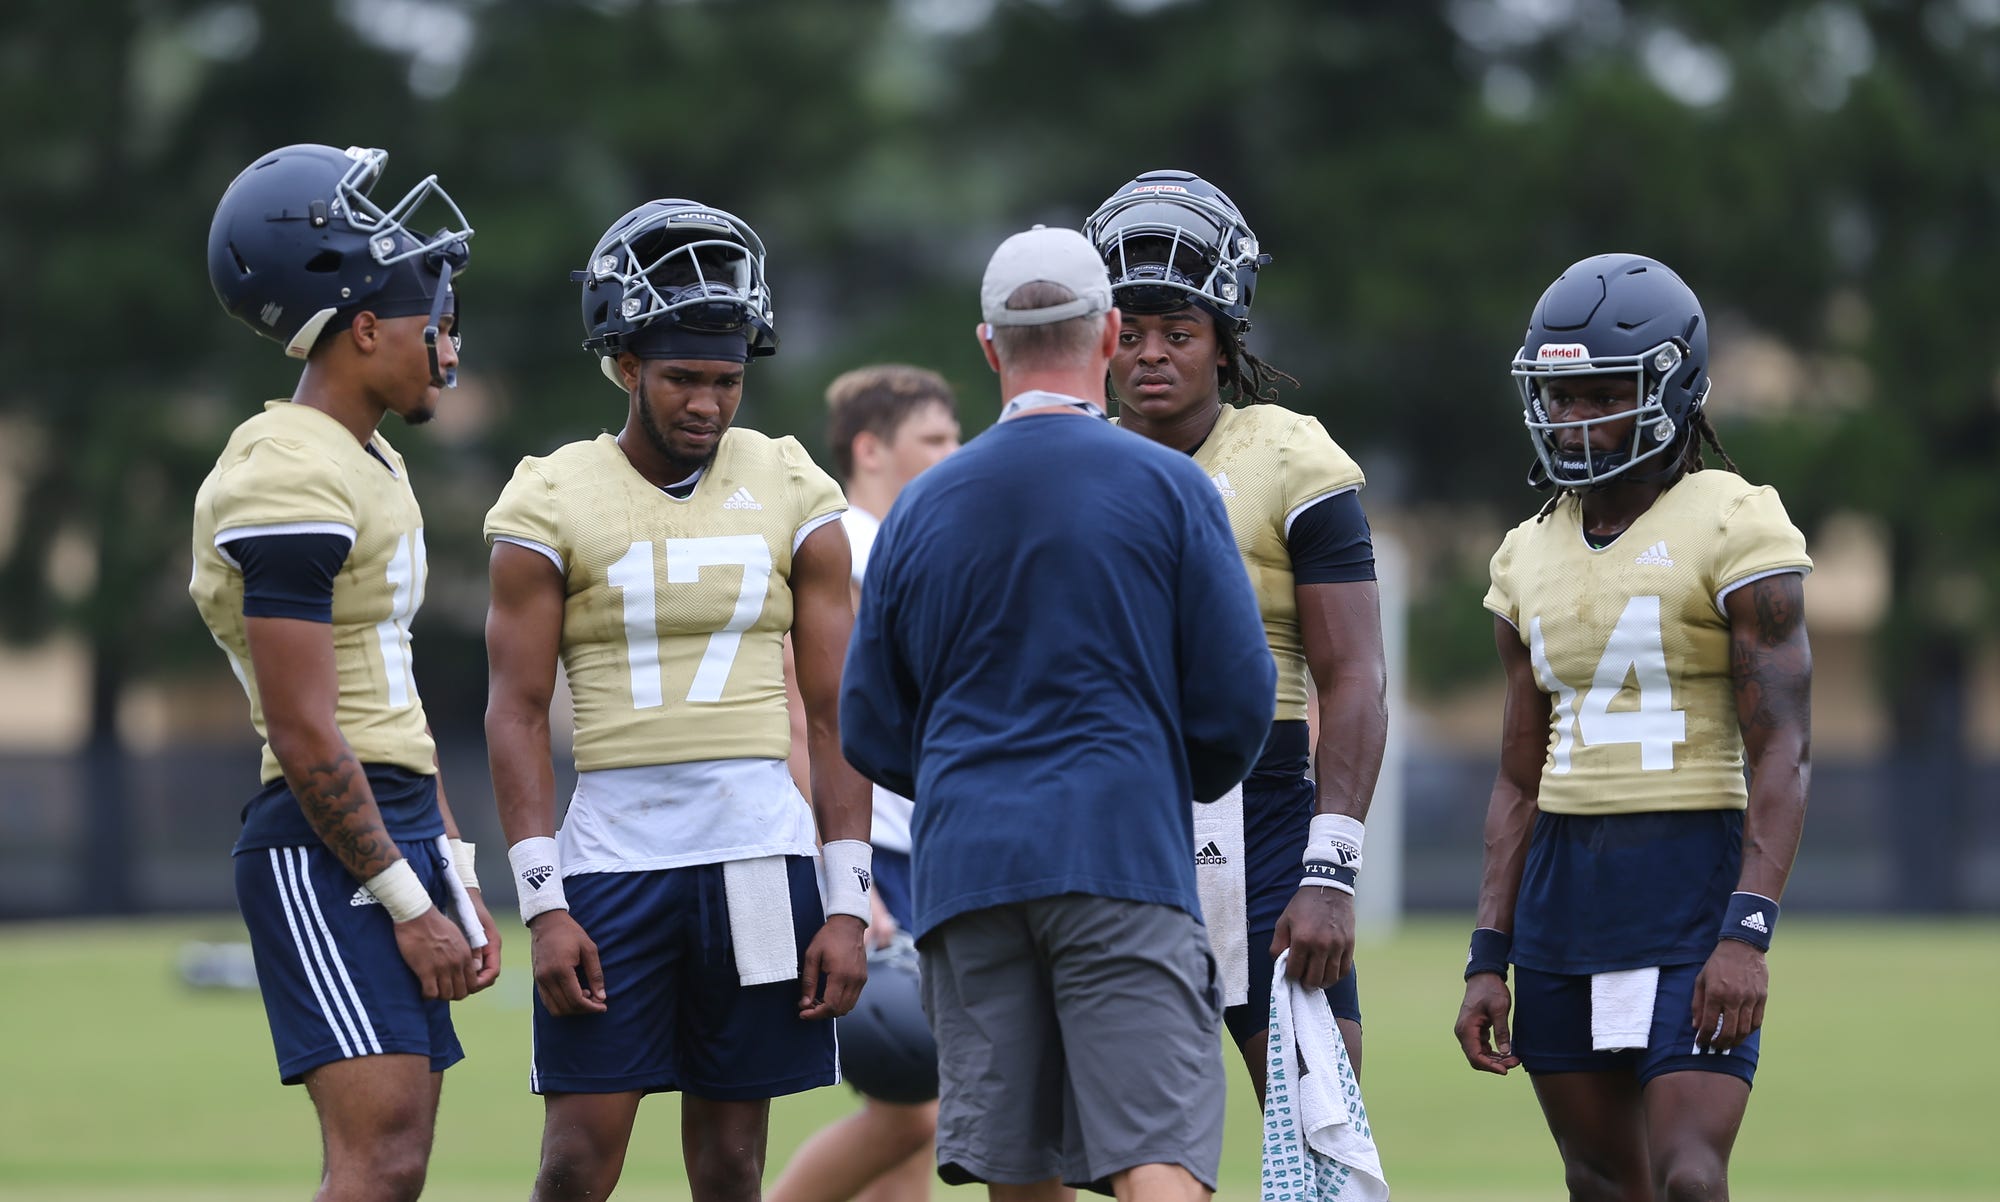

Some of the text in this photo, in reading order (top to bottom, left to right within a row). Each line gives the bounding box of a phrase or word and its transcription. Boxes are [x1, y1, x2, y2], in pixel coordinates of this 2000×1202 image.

[1541, 348, 1580, 358] Riddell
[1532, 398, 1553, 433] Riddl
[1562, 461, 1588, 470] Riddel
[723, 501, 763, 511] adidas
[1634, 557, 1674, 568] adidas
[607, 534, 772, 709] 17
[1529, 595, 1686, 774] 14
[521, 865, 554, 879] adidas
[1741, 920, 1768, 933] adidas
